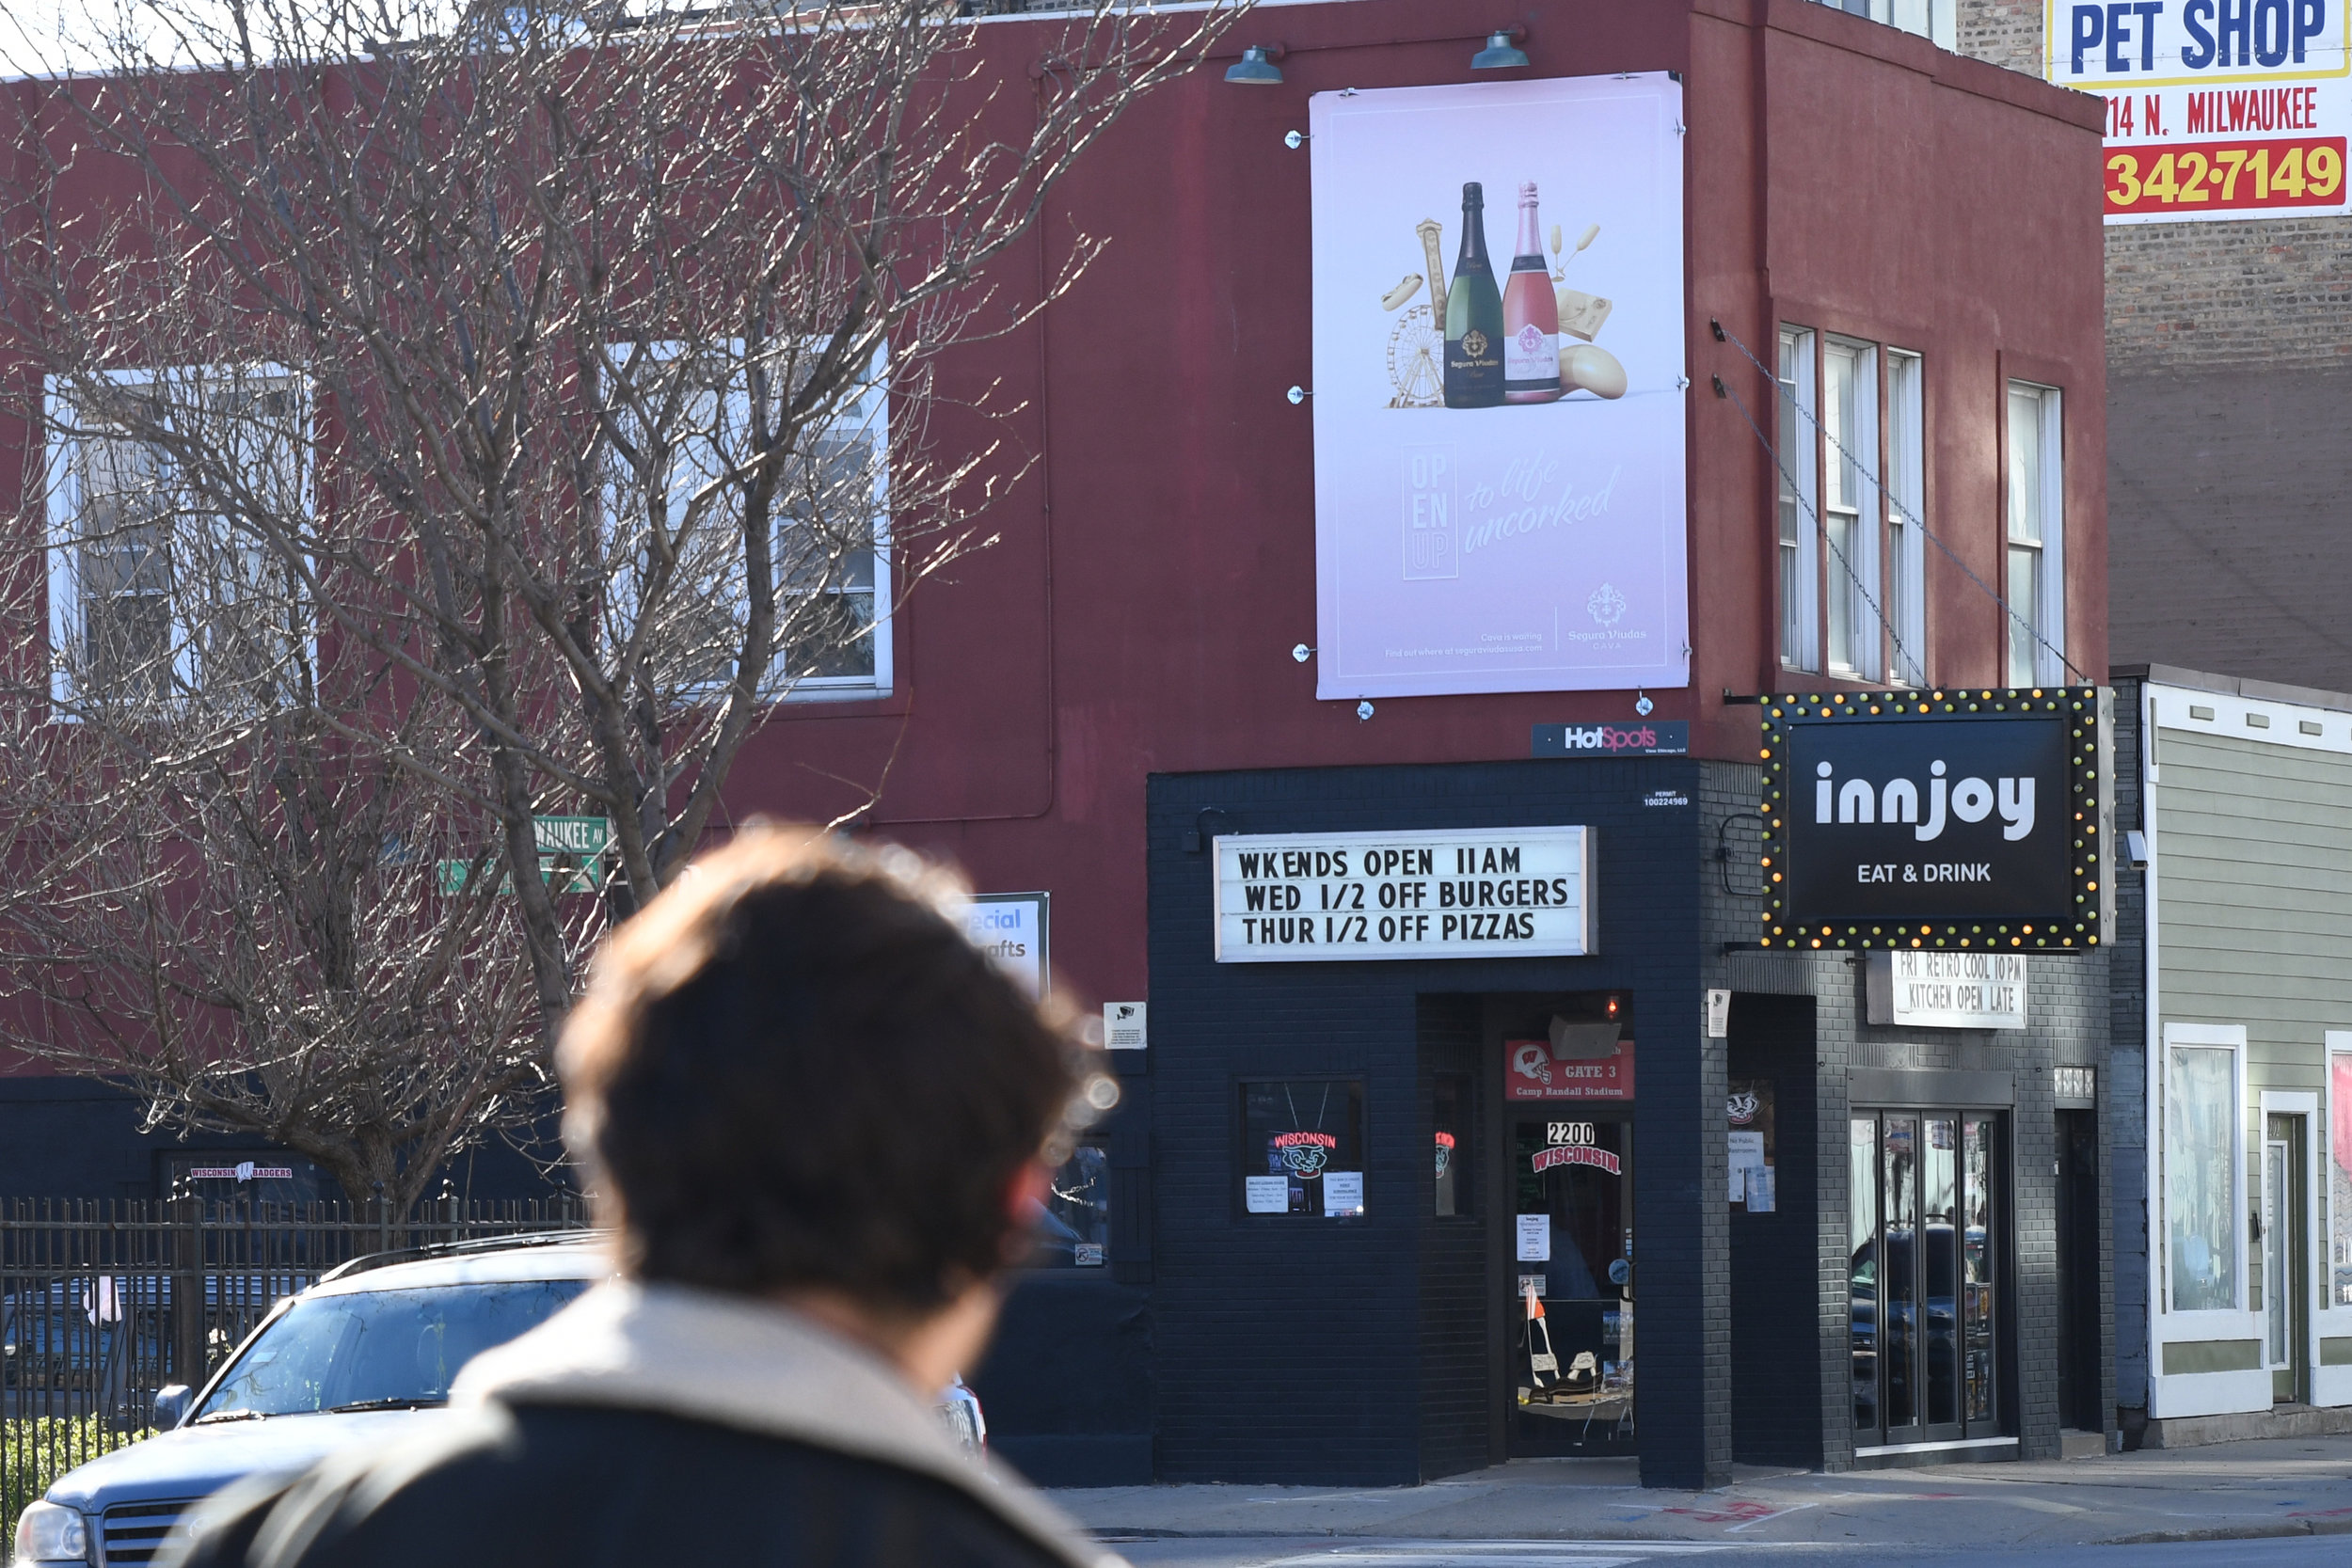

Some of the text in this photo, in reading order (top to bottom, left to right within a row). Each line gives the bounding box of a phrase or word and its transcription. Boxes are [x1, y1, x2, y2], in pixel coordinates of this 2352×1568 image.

[2071, 0, 2325, 74] PET SHOP
[2146, 94, 2169, 136] N.
[2187, 87, 2317, 134] MILWAUKEE
[1465, 447, 1559, 512] to life
[1465, 464, 1621, 554] uncorked
[1412, 531, 1449, 570] UP
[1481, 631, 1542, 642] Cava is waiting
[1568, 629, 1647, 643] Segura Viudas
[1385, 647, 1402, 657] Find
[1404, 647, 1418, 657] out
[1418, 646, 1442, 657] where
[1444, 646, 1454, 656] at
[1565, 725, 1656, 752] HotSpots
[1816, 759, 2035, 841] innjoy
[534, 821, 603, 848] WAUKEE AV
[1238, 850, 1348, 879] WKENDS
[1363, 849, 1434, 877] OPEN
[1858, 863, 1992, 882] EAT & DRINK
[1245, 879, 1568, 911] WED 1/2 OFF BURGERS
[963, 909, 1021, 929] ecial
[1243, 912, 1534, 944] THUR 1/2 OFF PIZZAS
[984, 940, 1026, 958] afts
[1900, 952, 1917, 976] FRI
[1927, 953, 1961, 977] RETRO
[1964, 955, 1990, 979] COOL
[1909, 983, 2014, 1012] KITCHEN OPEN LATE
[1521, 1050, 1538, 1065] W
[1565, 1066, 1616, 1078] GATE 3
[1517, 1086, 1623, 1098] Camp Randall Stadium
[1275, 1132, 1336, 1149] WISCONSIN
[1549, 1123, 1594, 1144] 2200
[192, 1168, 236, 1177] WISCONSIN
[252, 1168, 292, 1177] BADGERS
[1533, 1146, 1621, 1175] WISCONSIN
